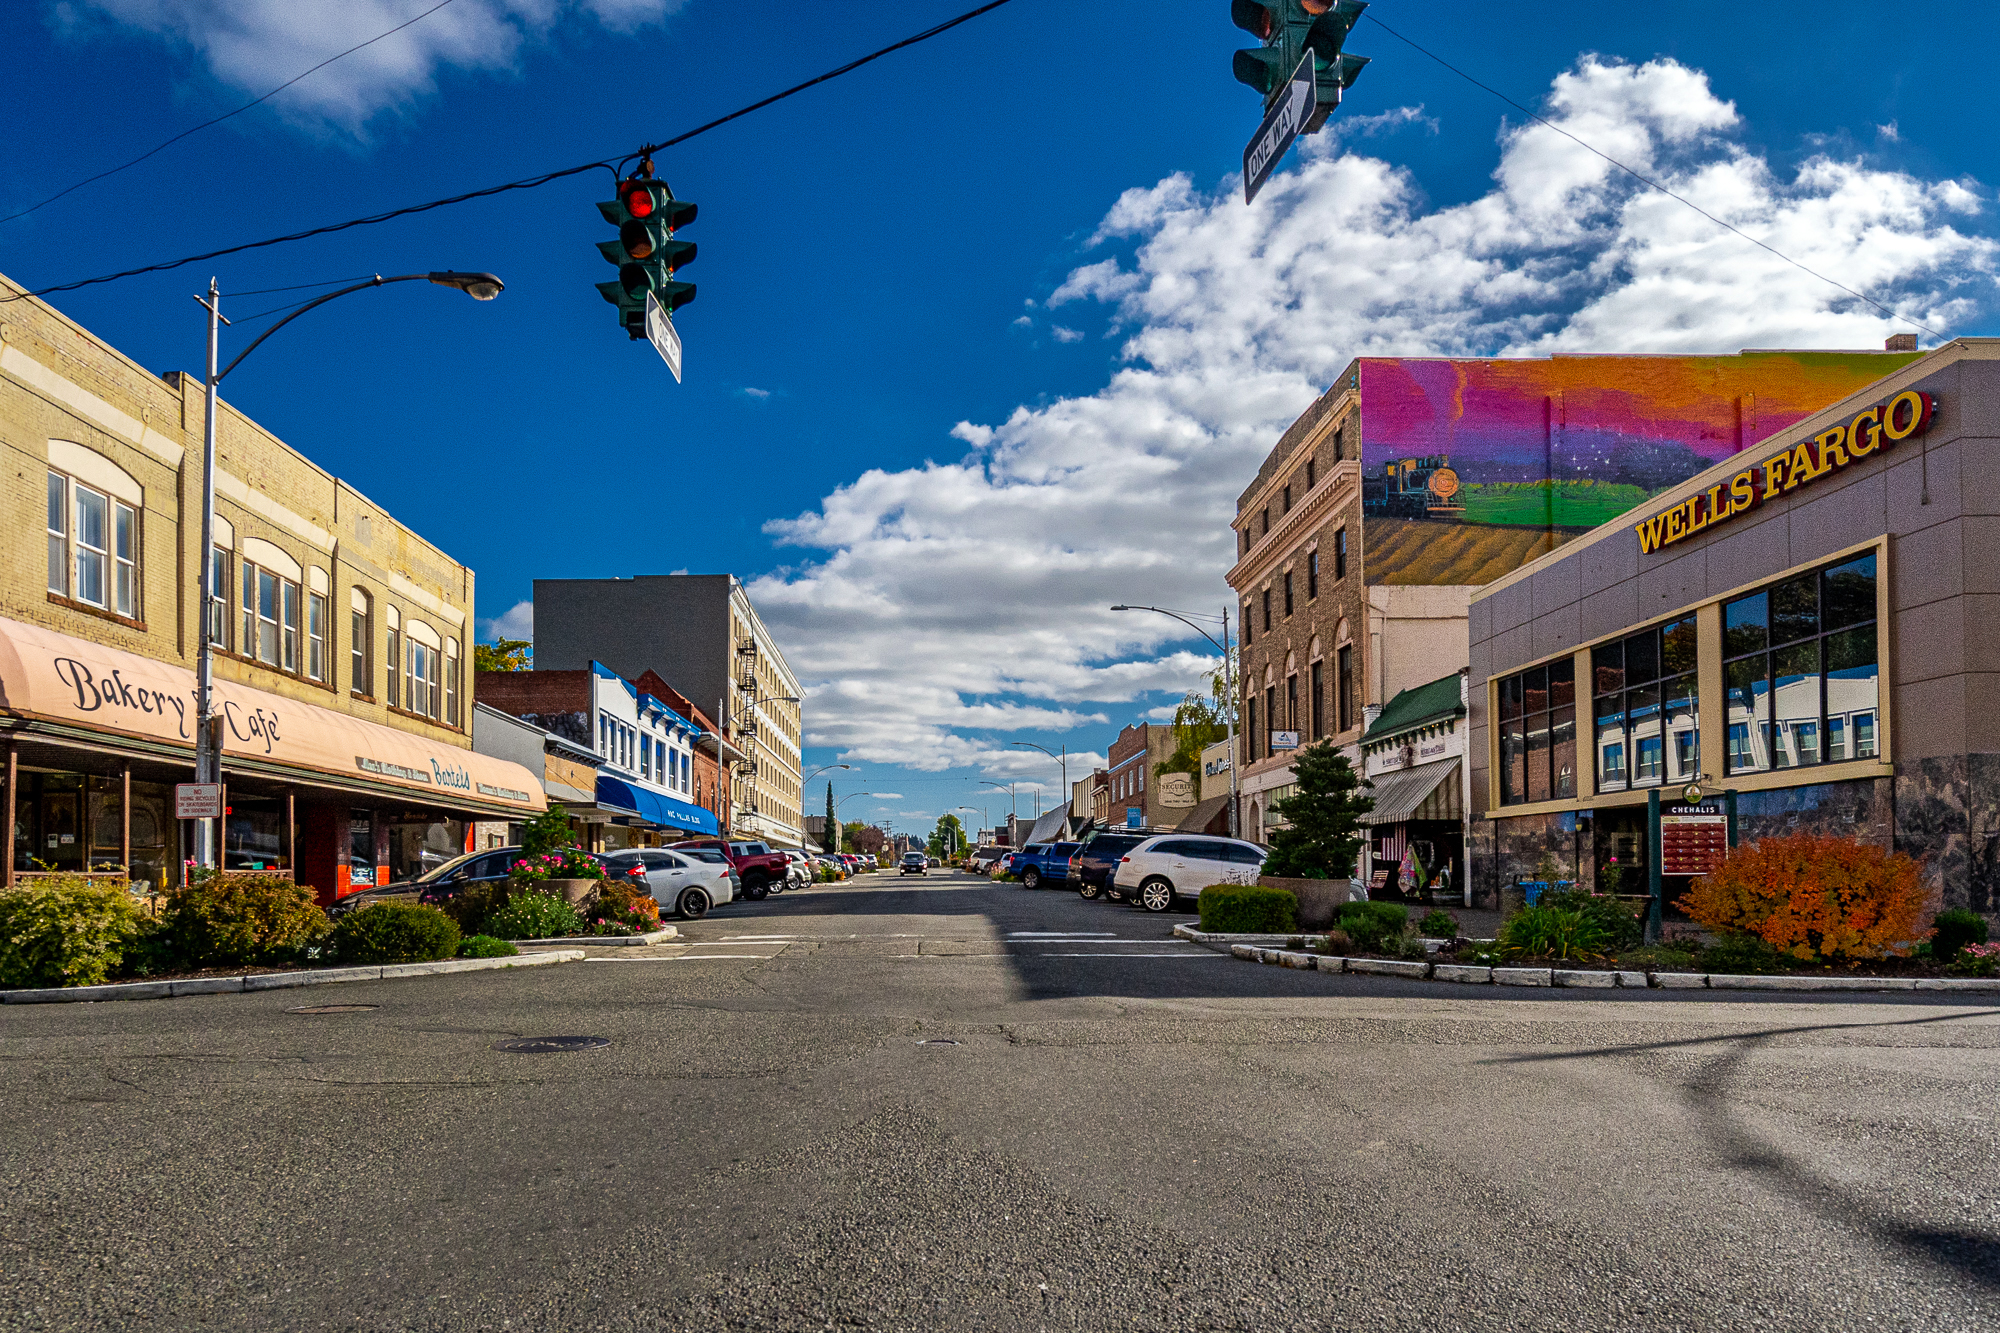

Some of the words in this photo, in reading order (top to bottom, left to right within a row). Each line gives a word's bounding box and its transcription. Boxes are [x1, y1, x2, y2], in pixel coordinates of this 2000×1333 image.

[1251, 134, 1271, 178] ONE
[1272, 97, 1294, 146] WAY
[1634, 469, 1756, 555] WELLS
[1762, 389, 1927, 501] FARGO
[53, 656, 191, 740] Bakery
[429, 757, 471, 791] Bartels
[1671, 806, 1715, 814] CHEHALIS
